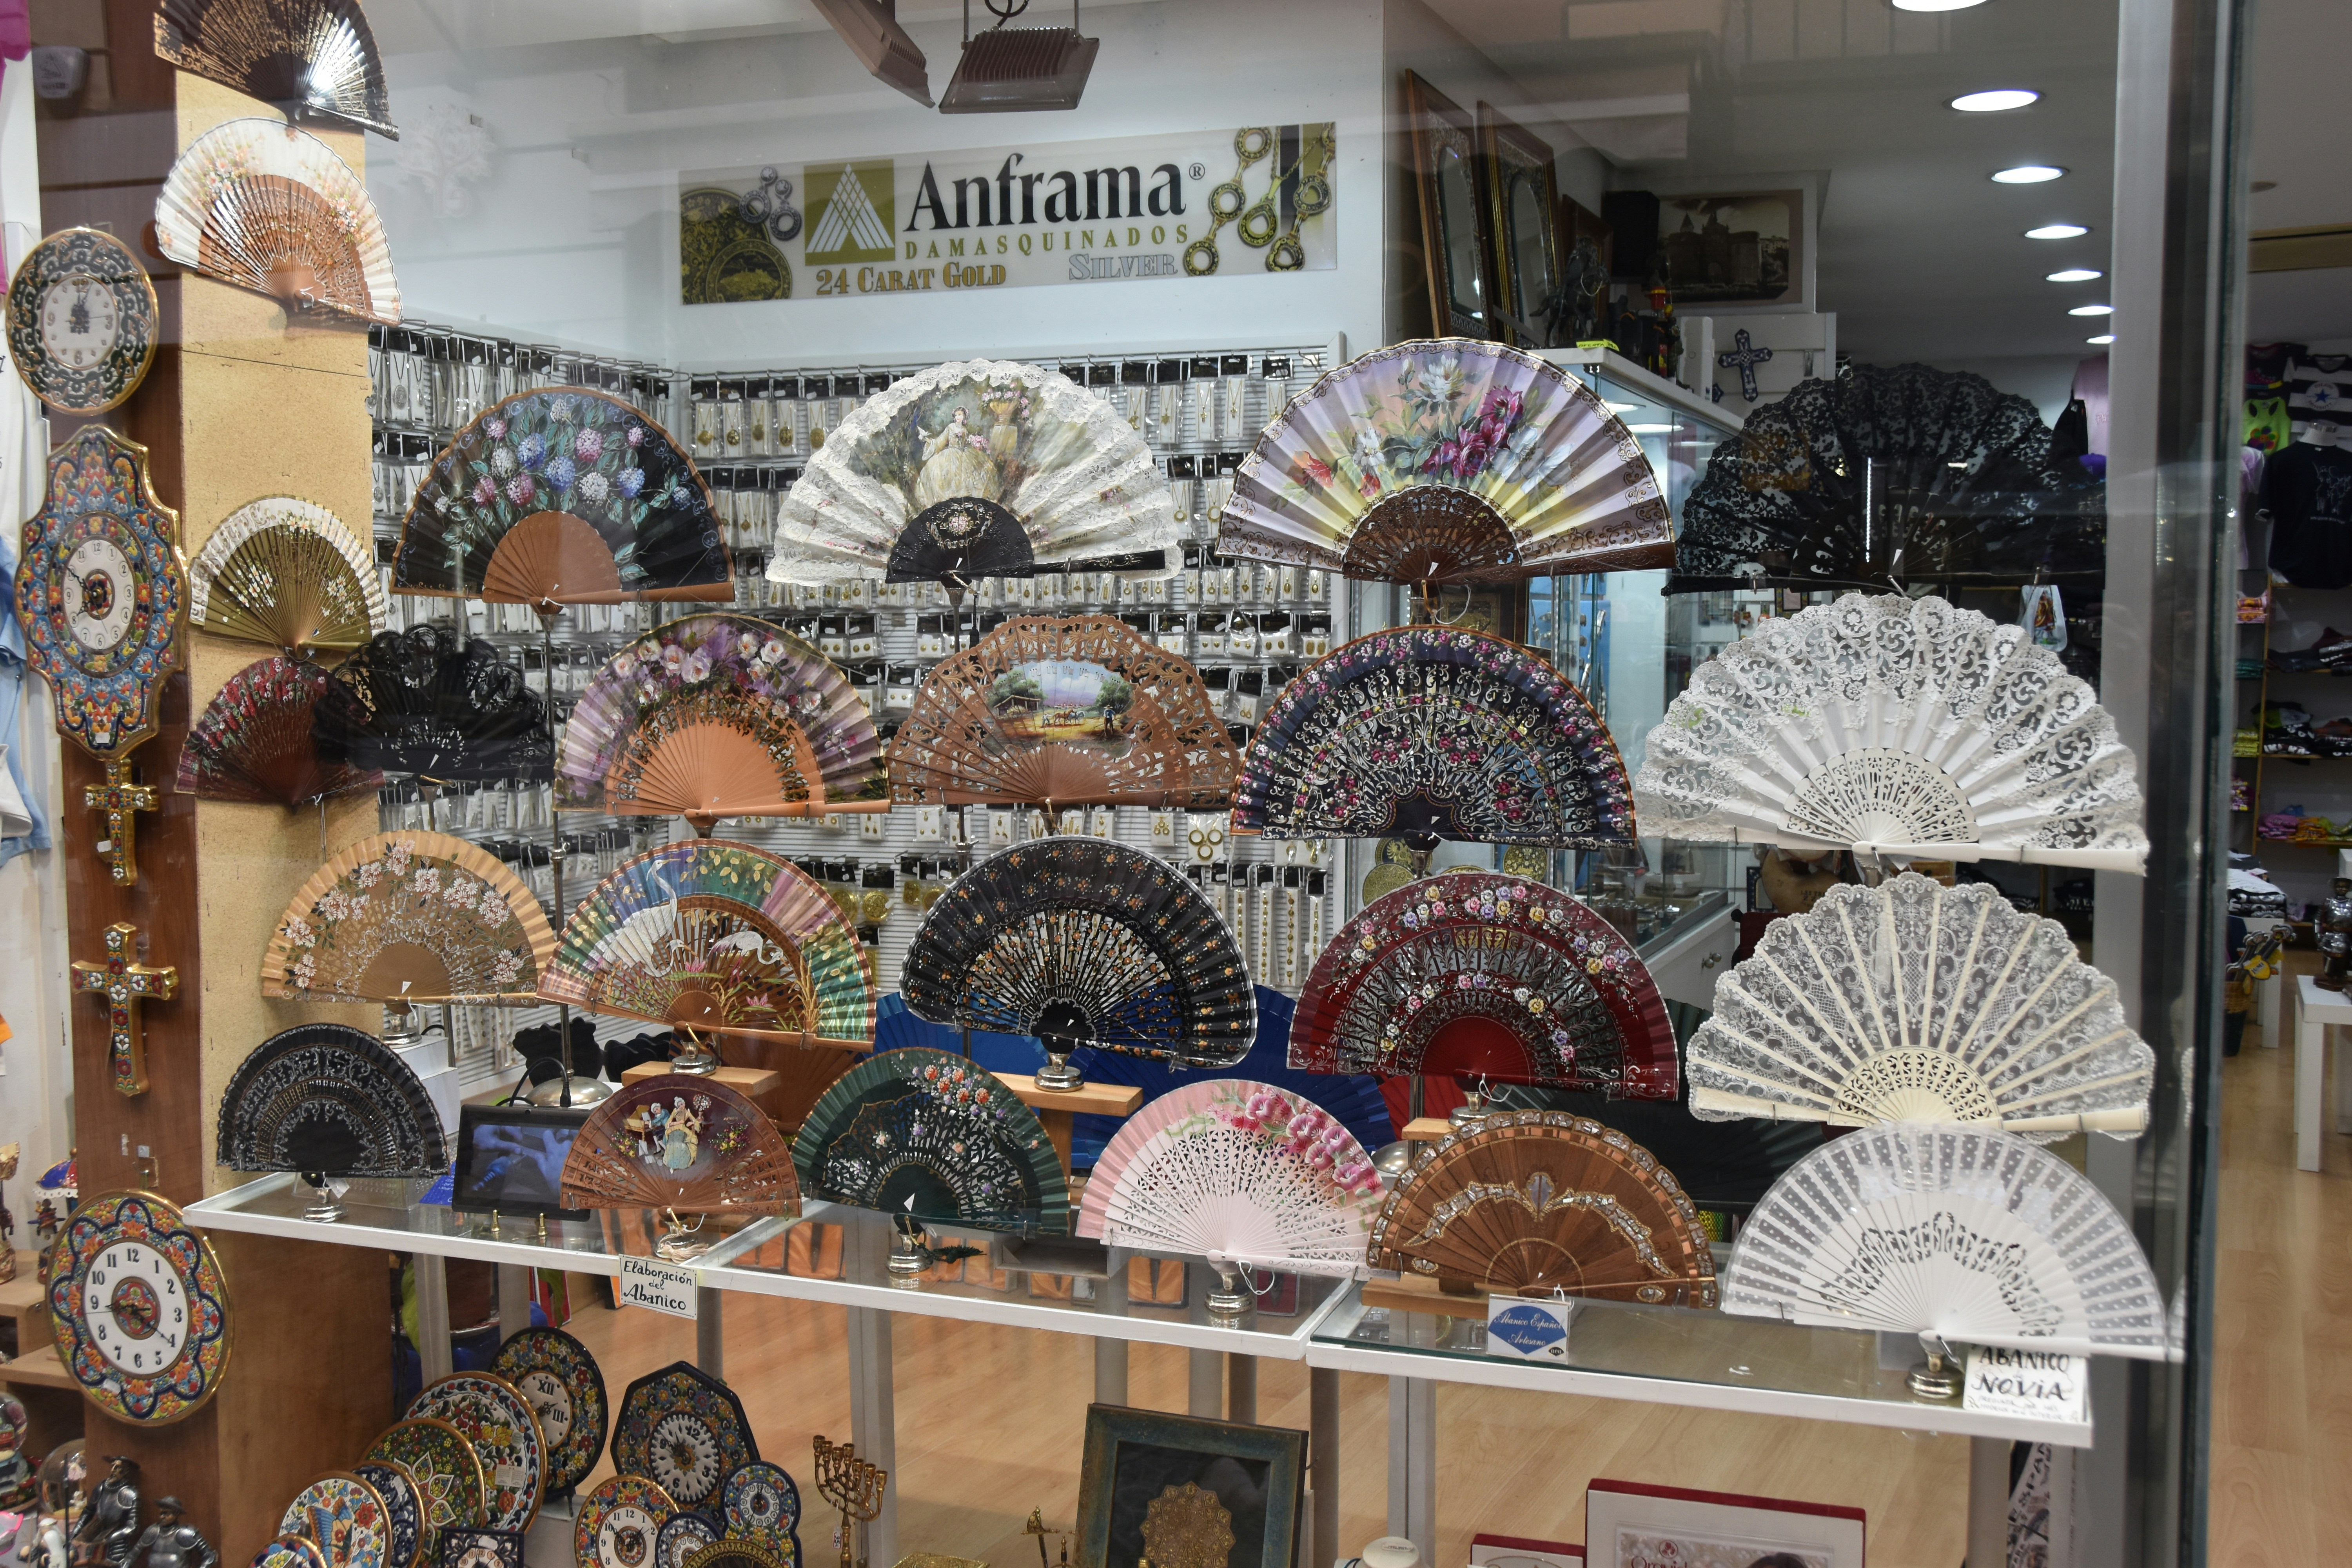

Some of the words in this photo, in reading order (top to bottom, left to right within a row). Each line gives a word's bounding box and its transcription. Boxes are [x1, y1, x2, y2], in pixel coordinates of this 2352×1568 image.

[904, 223, 1188, 260] DAMASQUINADOS
[815, 268, 850, 295] 24
[47, 312, 55, 327] 9
[105, 315, 114, 330] 3
[74, 350, 83, 365] 6
[93, 542, 100, 552] 12
[110, 548, 114, 557] 1
[78, 550, 85, 559] 11
[122, 565, 126, 573] 2
[67, 592, 71, 600] 9
[127, 589, 131, 598] 3
[72, 615, 76, 624] 8
[123, 611, 128, 620] 4
[83, 632, 87, 641] 7
[98, 637, 102, 646] 6
[114, 630, 118, 639] 5
[107, 1254, 117, 1268] 11
[127, 1248, 140, 1263] 12
[154, 1259, 160, 1274] 1
[624, 1260, 692, 1286] Elaboración
[91, 1270, 105, 1285] 10
[648, 1279, 664, 1290] del
[167, 1279, 176, 1294] 2
[90, 1295, 99, 1310] 9
[623, 1283, 686, 1310] Abanico
[174, 1307, 182, 1323] 3
[1494, 1311, 1528, 1326] Abanico
[1530, 1313, 1565, 1331] Español
[98, 1325, 107, 1340] 8
[1508, 1330, 1546, 1346] Artesano
[167, 1334, 176, 1348] 4
[114, 1345, 122, 1361] 7
[155, 1351, 162, 1365] 5
[134, 1353, 142, 1368] 6
[537, 1379, 555, 1396] XII
[552, 1409, 564, 1424] III
[613, 1512, 620, 1521] 11
[626, 1509, 635, 1518] 12
[642, 1515, 645, 1523] 1
[604, 1523, 613, 1532] 10
[650, 1527, 655, 1535] 2
[601, 1539, 606, 1547] 9
[605, 1557, 610, 1565] 8
